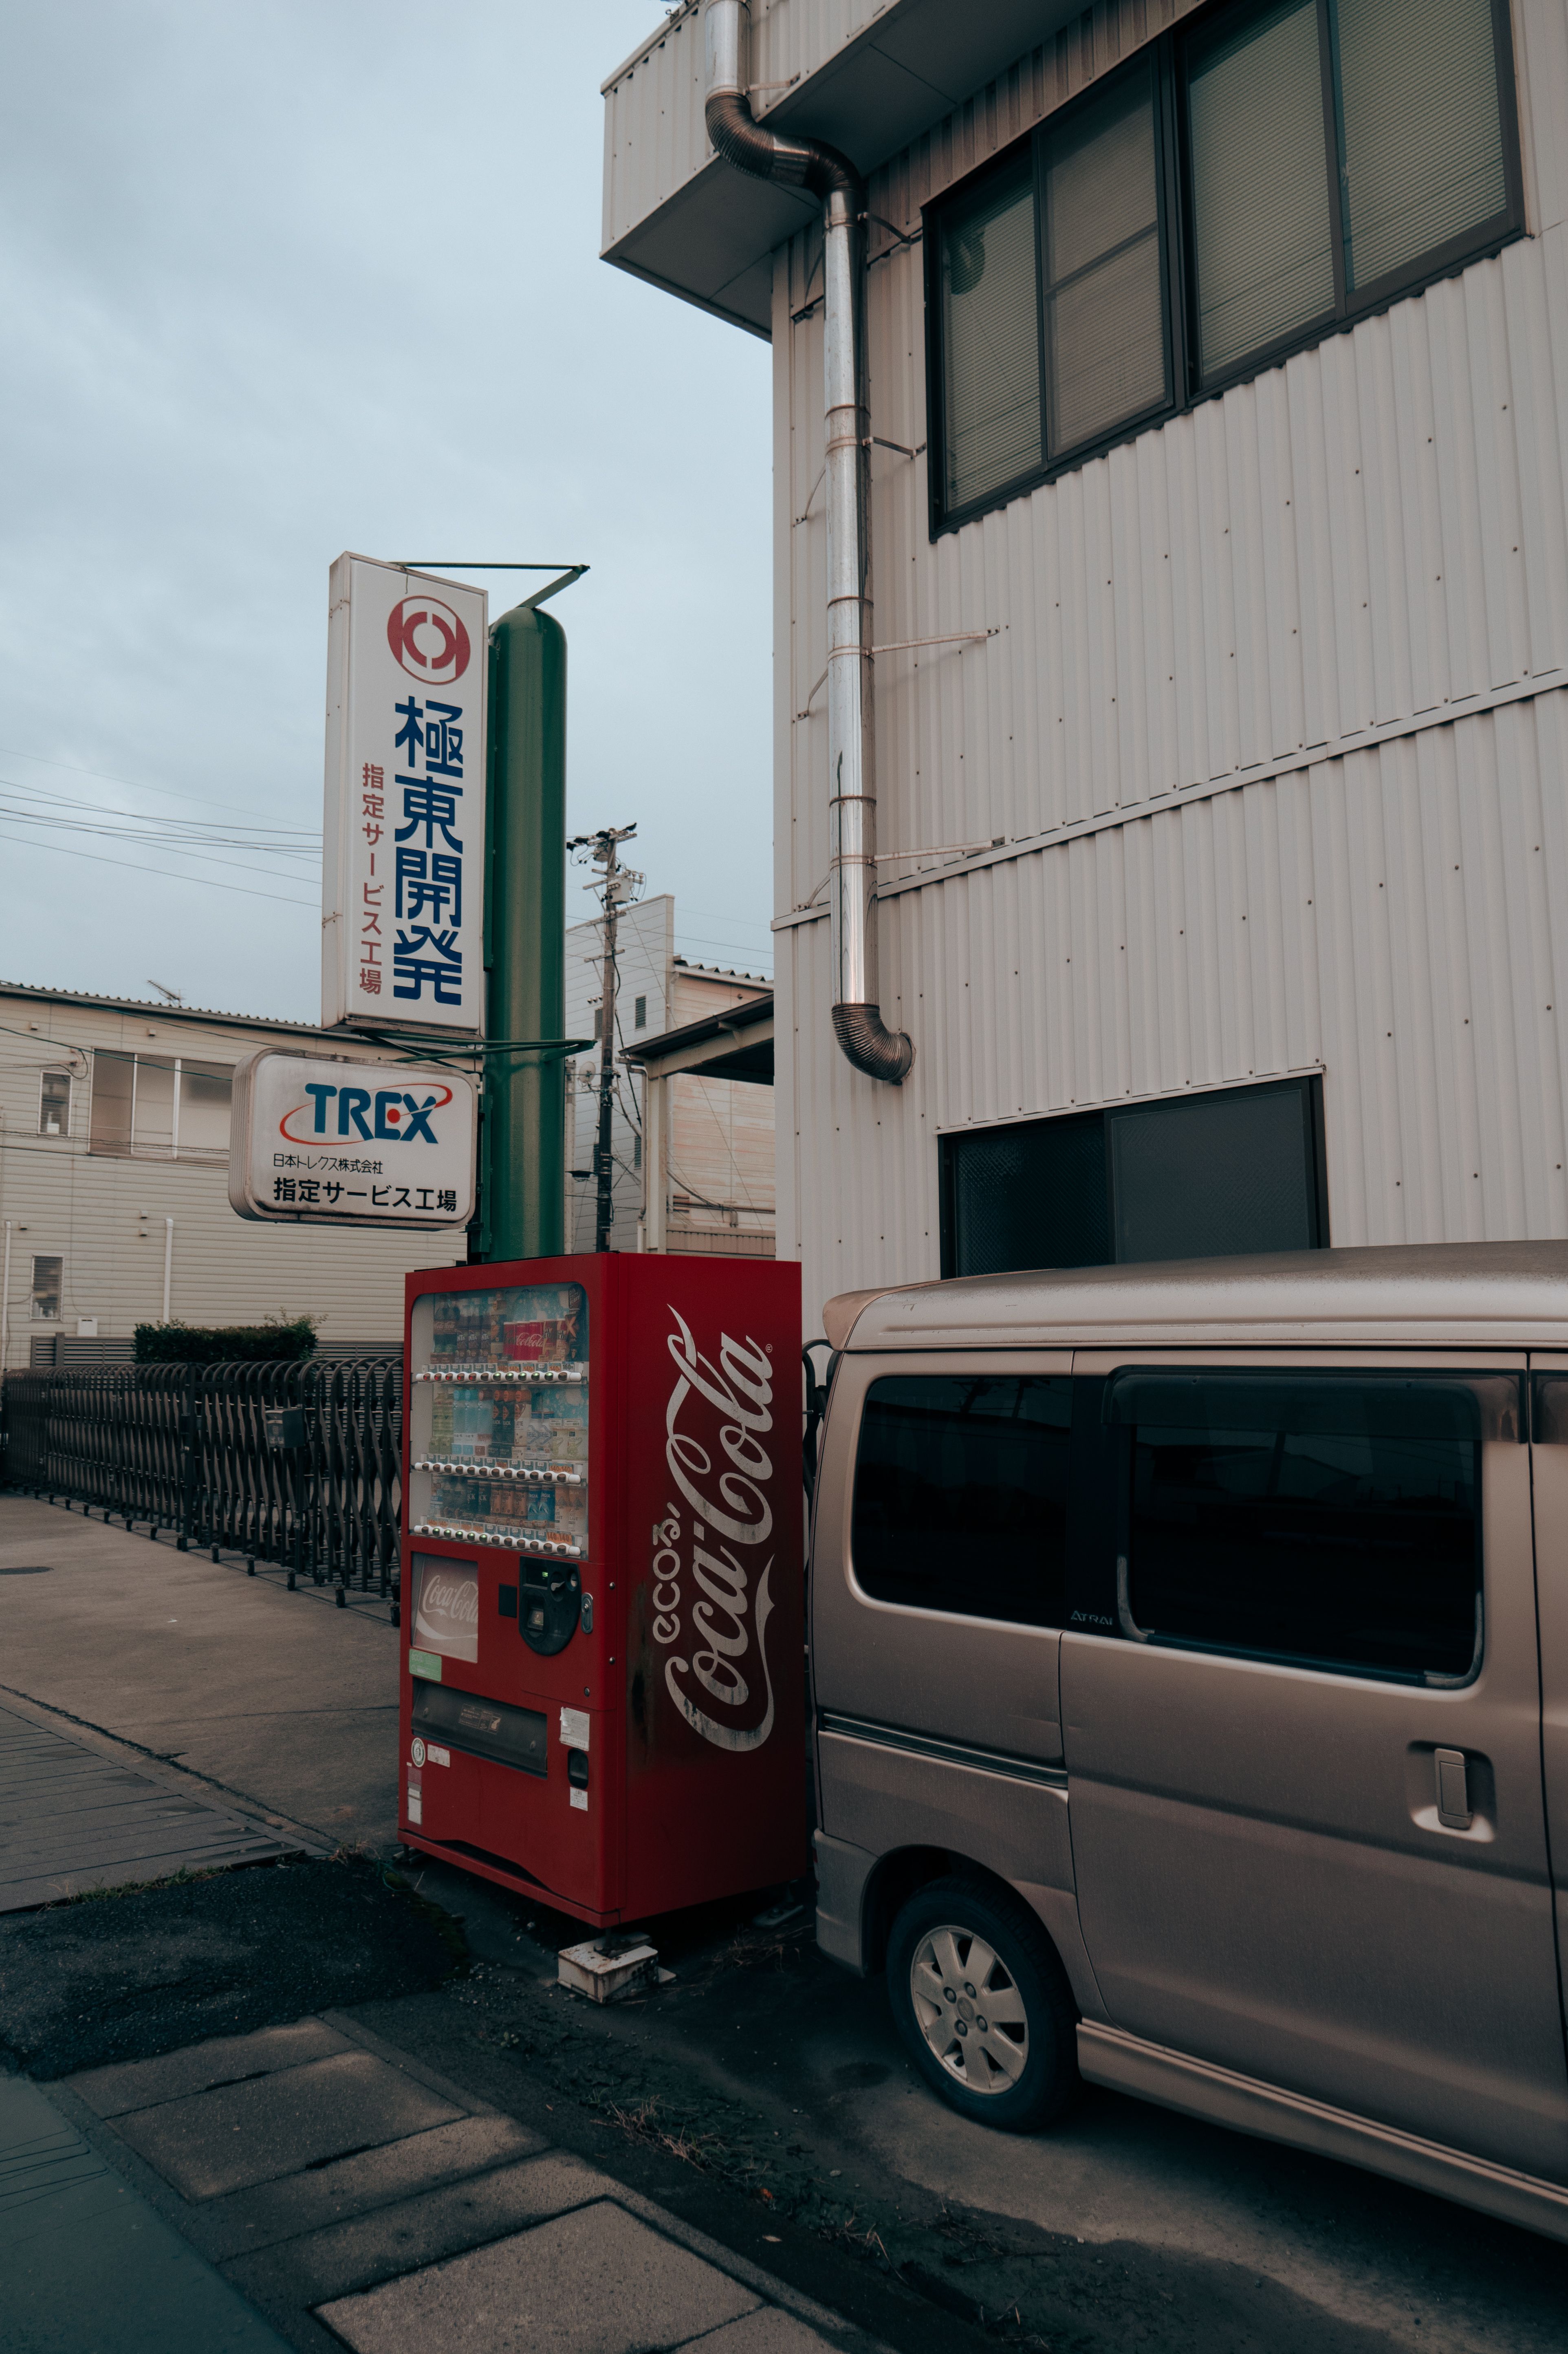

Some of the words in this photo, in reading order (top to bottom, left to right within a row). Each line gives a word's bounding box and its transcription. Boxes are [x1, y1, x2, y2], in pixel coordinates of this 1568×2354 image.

[394, 695, 463, 1006] 極東開発
[359, 762, 385, 995] 指定サービス工場
[305, 1082, 439, 1144] TREX
[273, 1153, 383, 1174] 日本トレクス株式会社
[273, 1177, 457, 1212] 指定サービス工場
[1070, 1610, 1113, 1625] ATRAI
